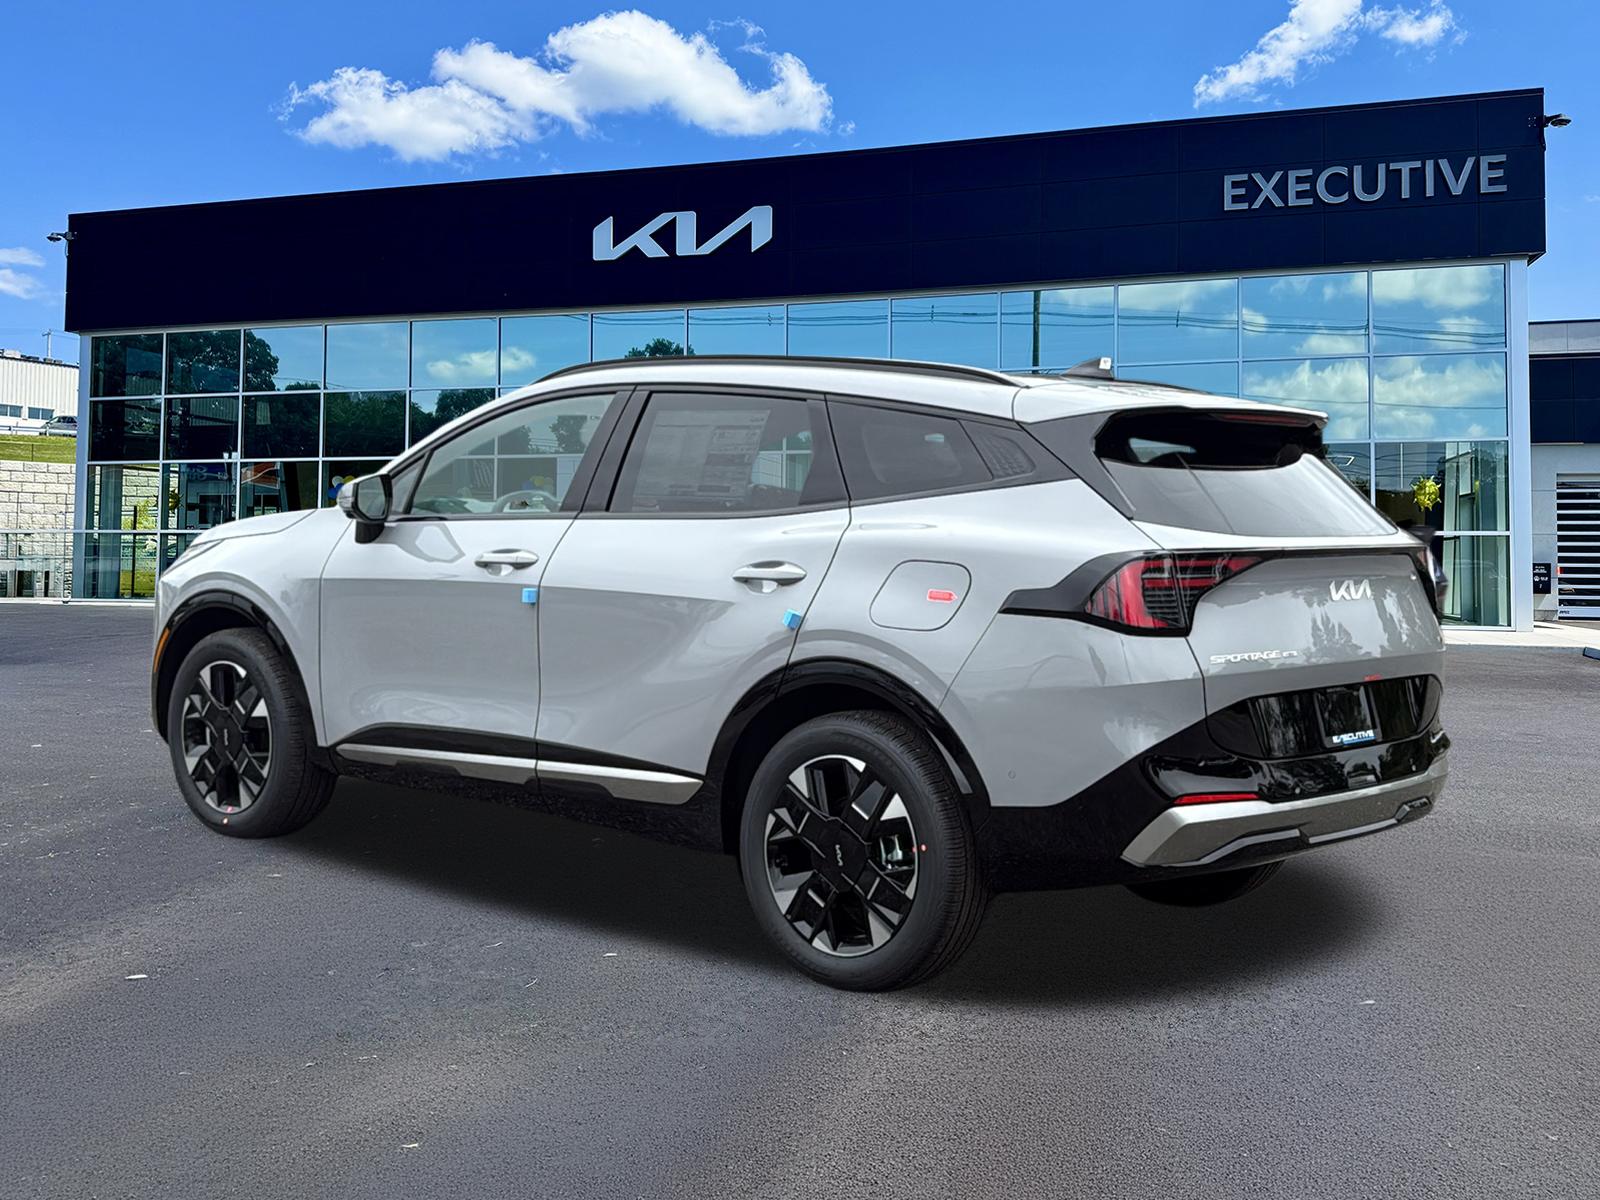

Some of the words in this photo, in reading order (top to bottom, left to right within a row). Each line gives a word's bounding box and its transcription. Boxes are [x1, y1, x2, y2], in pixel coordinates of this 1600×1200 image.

[1223, 154, 1508, 211] EXECUTIVE
[592, 205, 773, 261] KIA
[1329, 579, 1371, 601] KIA
